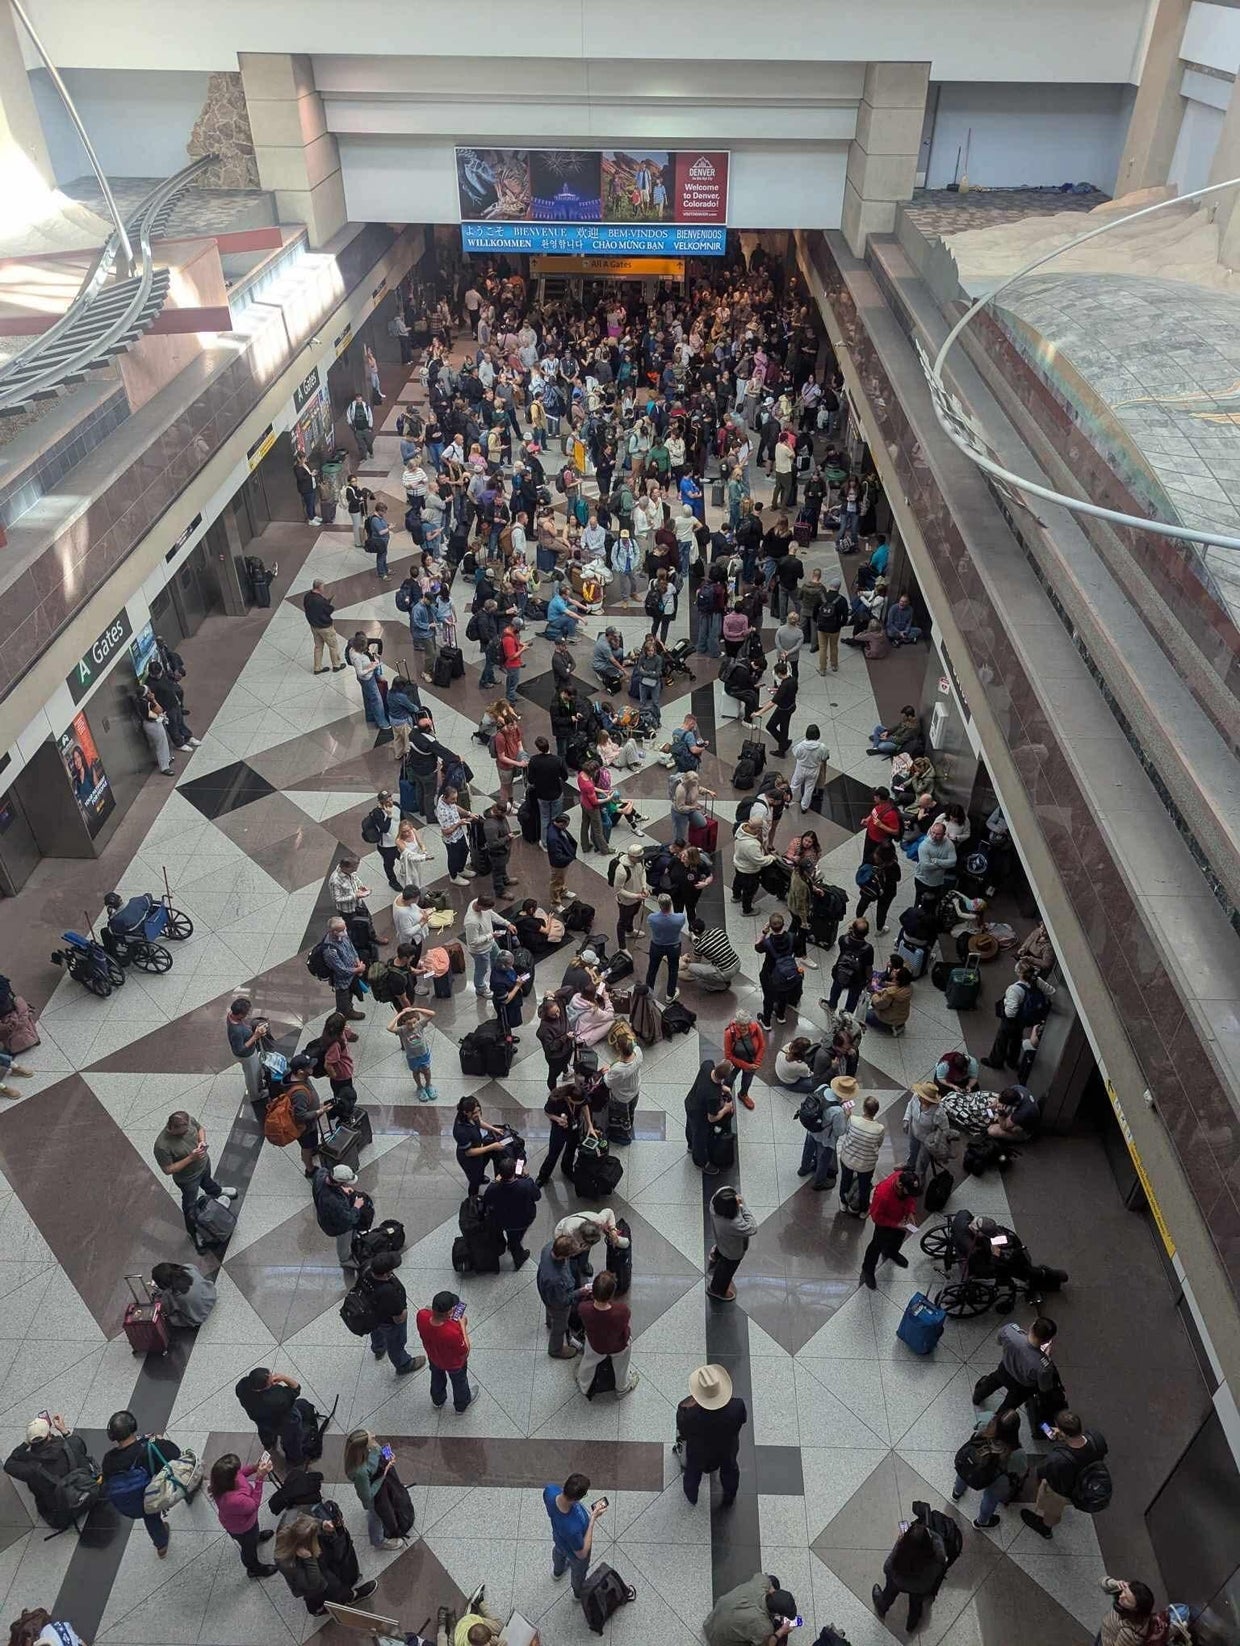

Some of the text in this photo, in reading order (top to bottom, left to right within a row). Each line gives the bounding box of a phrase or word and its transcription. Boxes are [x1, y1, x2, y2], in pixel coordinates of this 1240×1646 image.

[689, 168, 716, 177] DENVER
[684, 183, 719, 191] Welcome
[692, 192, 720, 200] Denver,
[683, 200, 719, 208] Colorado!
[465, 226, 504, 237] ようこそ
[514, 227, 567, 237] BIENVENUE
[577, 226, 599, 239] 欢迎
[676, 230, 722, 239] BIENVENIDOS
[468, 238, 532, 248] WILLKOMMEN
[541, 239, 583, 249] 환영합니다
[647, 241, 665, 251] BẠN
[673, 241, 722, 251] VELKOMNIR
[591, 260, 602, 268] All
[610, 261, 632, 269] Gates
[297, 386, 304, 403] A
[303, 371, 317, 395] Gates
[80, 620, 124, 684] A Gates
